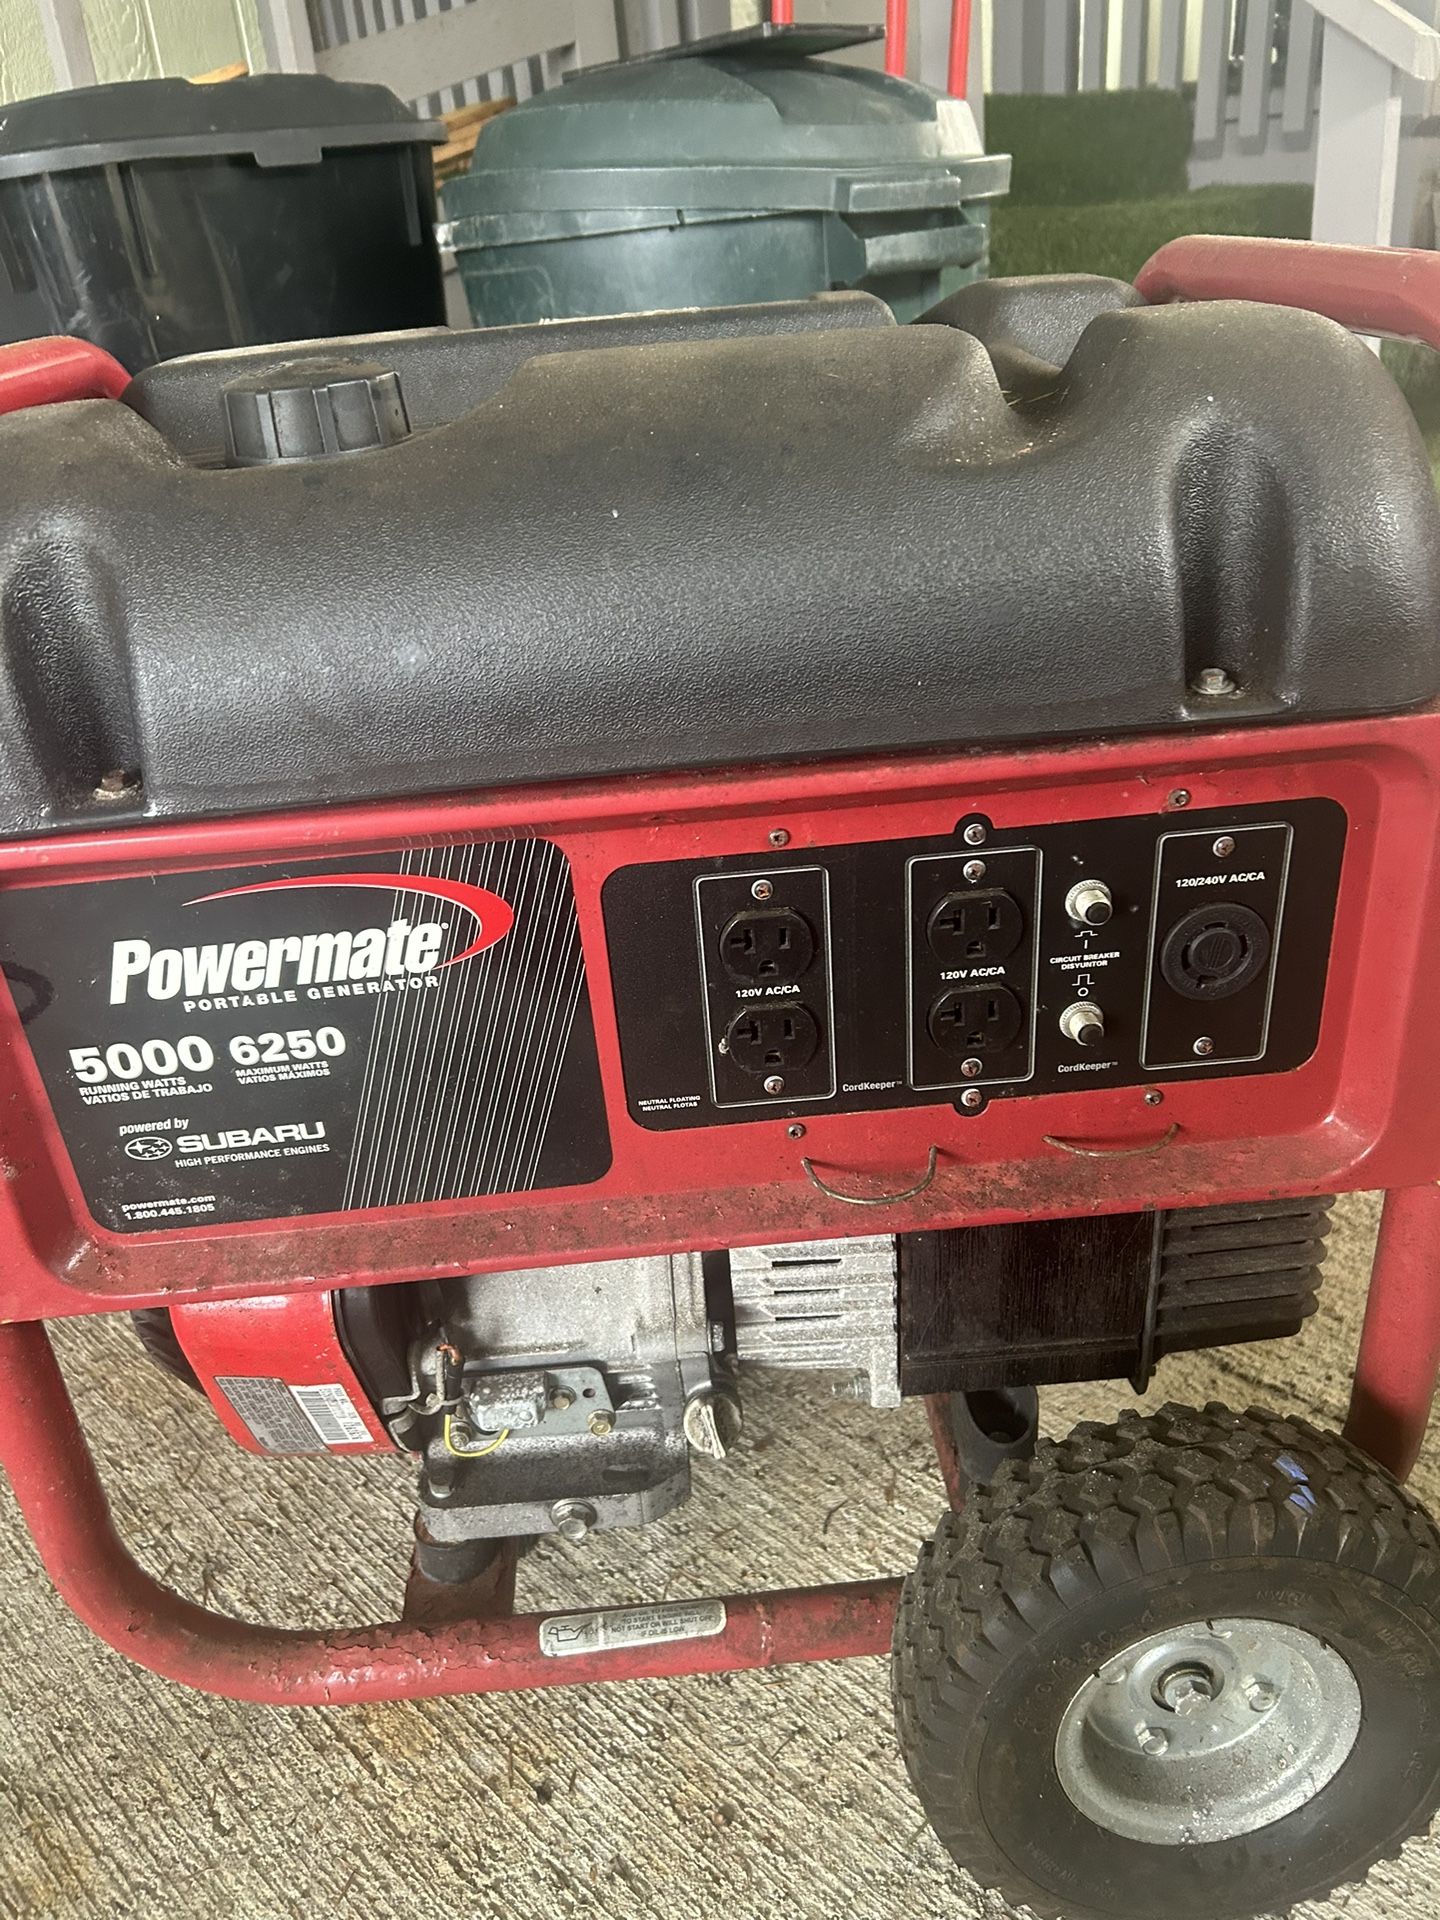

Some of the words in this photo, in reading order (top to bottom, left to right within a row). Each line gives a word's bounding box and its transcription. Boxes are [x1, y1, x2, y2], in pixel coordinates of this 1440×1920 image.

[1176, 875, 1227, 888] 120/240V
[1229, 871, 1265, 883] AC/CA
[1050, 954, 1082, 964] CIRCUIT
[1083, 951, 1120, 960] BREAKER
[1061, 960, 1108, 970] DISYUNTOR
[940, 969, 968, 980] 120V
[970, 966, 1006, 977] AC/CA
[183, 990, 297, 1013] PORTABLE
[307, 975, 440, 999] GENERATOR
[736, 988, 762, 998] 120V
[765, 985, 800, 996] AC/CA
[229, 1026, 346, 1066] 6250
[69, 1035, 214, 1084] 5000
[235, 1065, 290, 1077] MAXIMUM
[291, 1061, 329, 1071] WATTS
[79, 1081, 140, 1097] RUNNING
[141, 1076, 186, 1089] WATTS
[238, 1074, 276, 1085] VATIOS
[83, 1092, 130, 1105] VATIOS
[132, 1090, 150, 1101] DE
[151, 1083, 213, 1098] TRABAJO
[638, 1098, 668, 1106] NEUTRAL
[669, 1095, 701, 1103] FLOATING
[119, 1118, 172, 1136] powered
[175, 1118, 189, 1130] by
[176, 1121, 326, 1153] SUBARU
[175, 1158, 202, 1168] HIGH
[204, 1150, 282, 1165] PERFORMANCE
[284, 1144, 330, 1156] ENGINES
[121, 1194, 216, 1212] powermate.com
[125, 1203, 215, 1220] 1.800.445.1805
[611, 1626, 626, 1634] NOT
[627, 1623, 649, 1632] START
[651, 1621, 661, 1629] OR
[662, 1619, 679, 1627] WILL
[680, 1616, 698, 1625] SHUT
